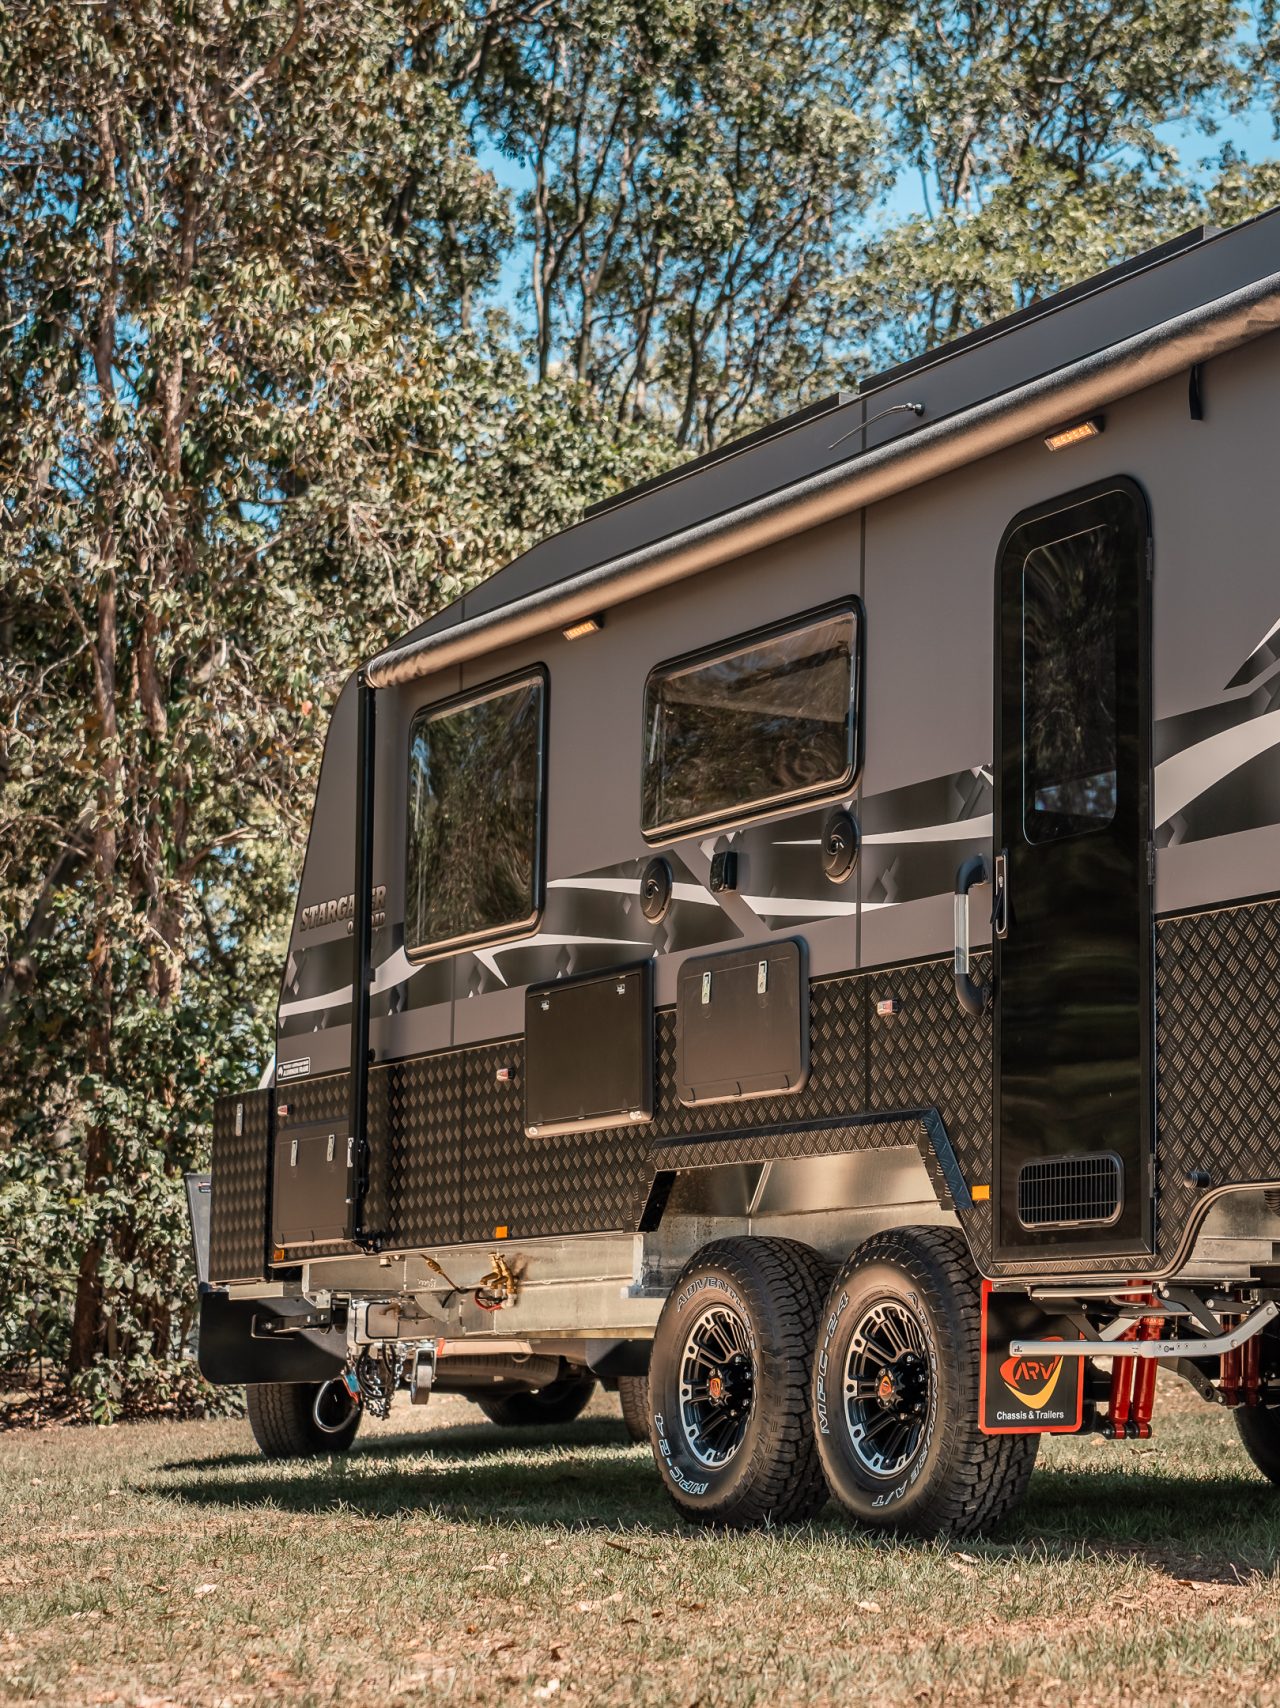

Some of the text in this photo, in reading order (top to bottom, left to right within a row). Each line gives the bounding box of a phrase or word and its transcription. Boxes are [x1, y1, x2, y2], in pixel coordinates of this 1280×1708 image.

[300, 885, 387, 932] STARGAR
[814, 1290, 850, 1435] MPC-24
[1015, 1361, 1055, 1380] ARV
[996, 1411, 1064, 1420] Chassis & Trailers
